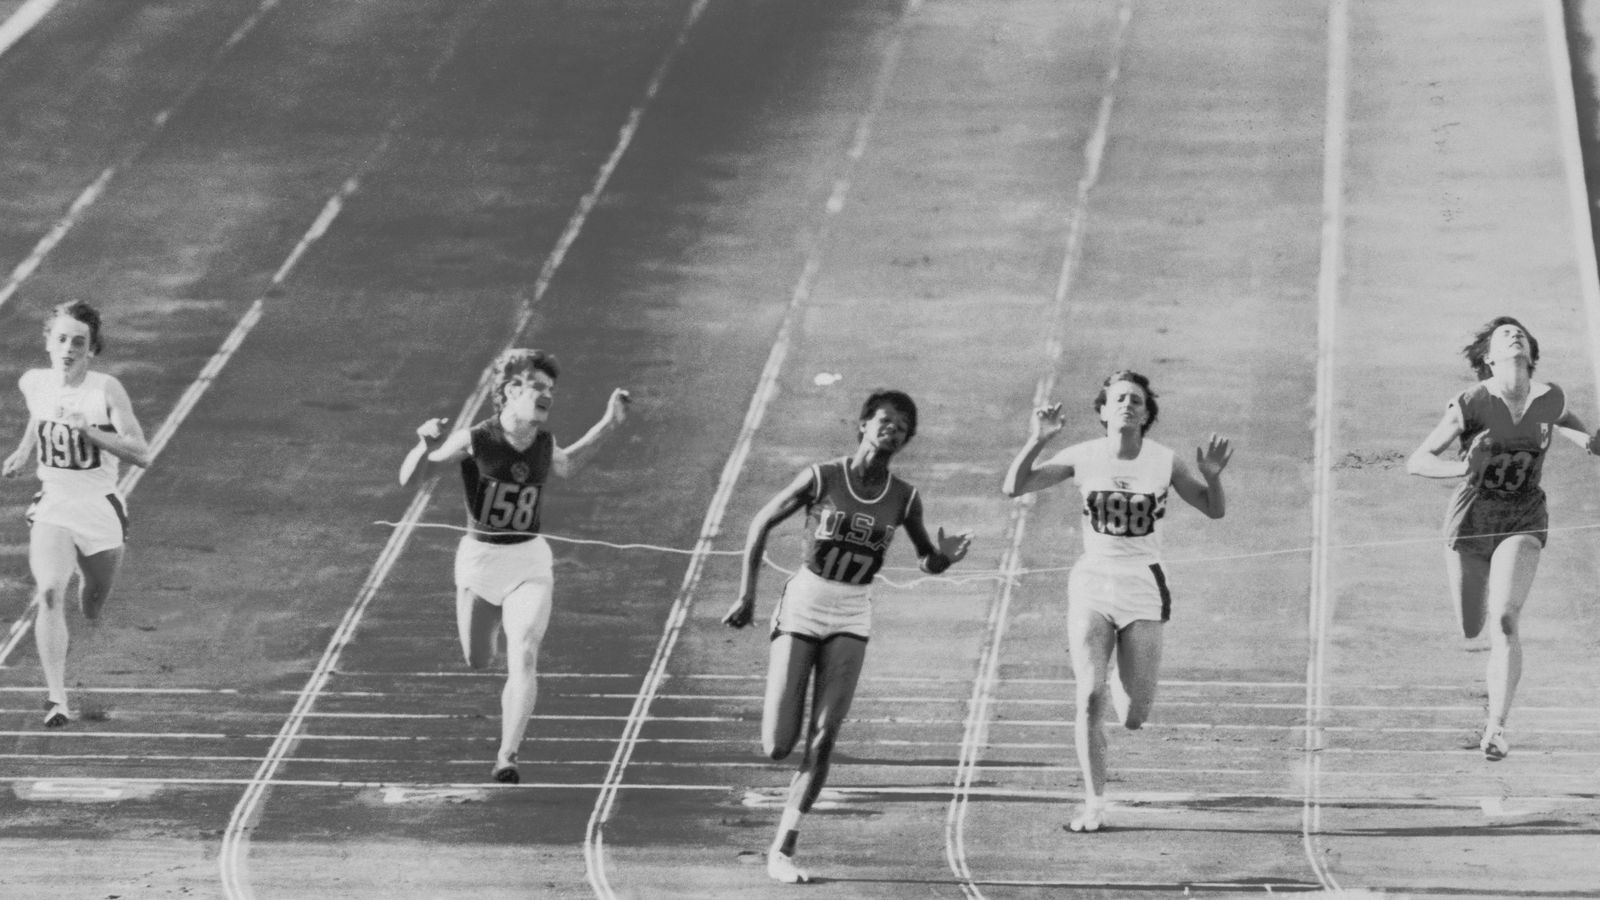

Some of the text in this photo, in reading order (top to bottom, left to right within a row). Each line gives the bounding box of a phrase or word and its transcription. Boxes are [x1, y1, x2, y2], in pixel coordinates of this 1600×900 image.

[42, 421, 94, 468] 190
[480, 481, 539, 530] 158
[1095, 492, 1152, 535] 188
[820, 546, 874, 584] 117
